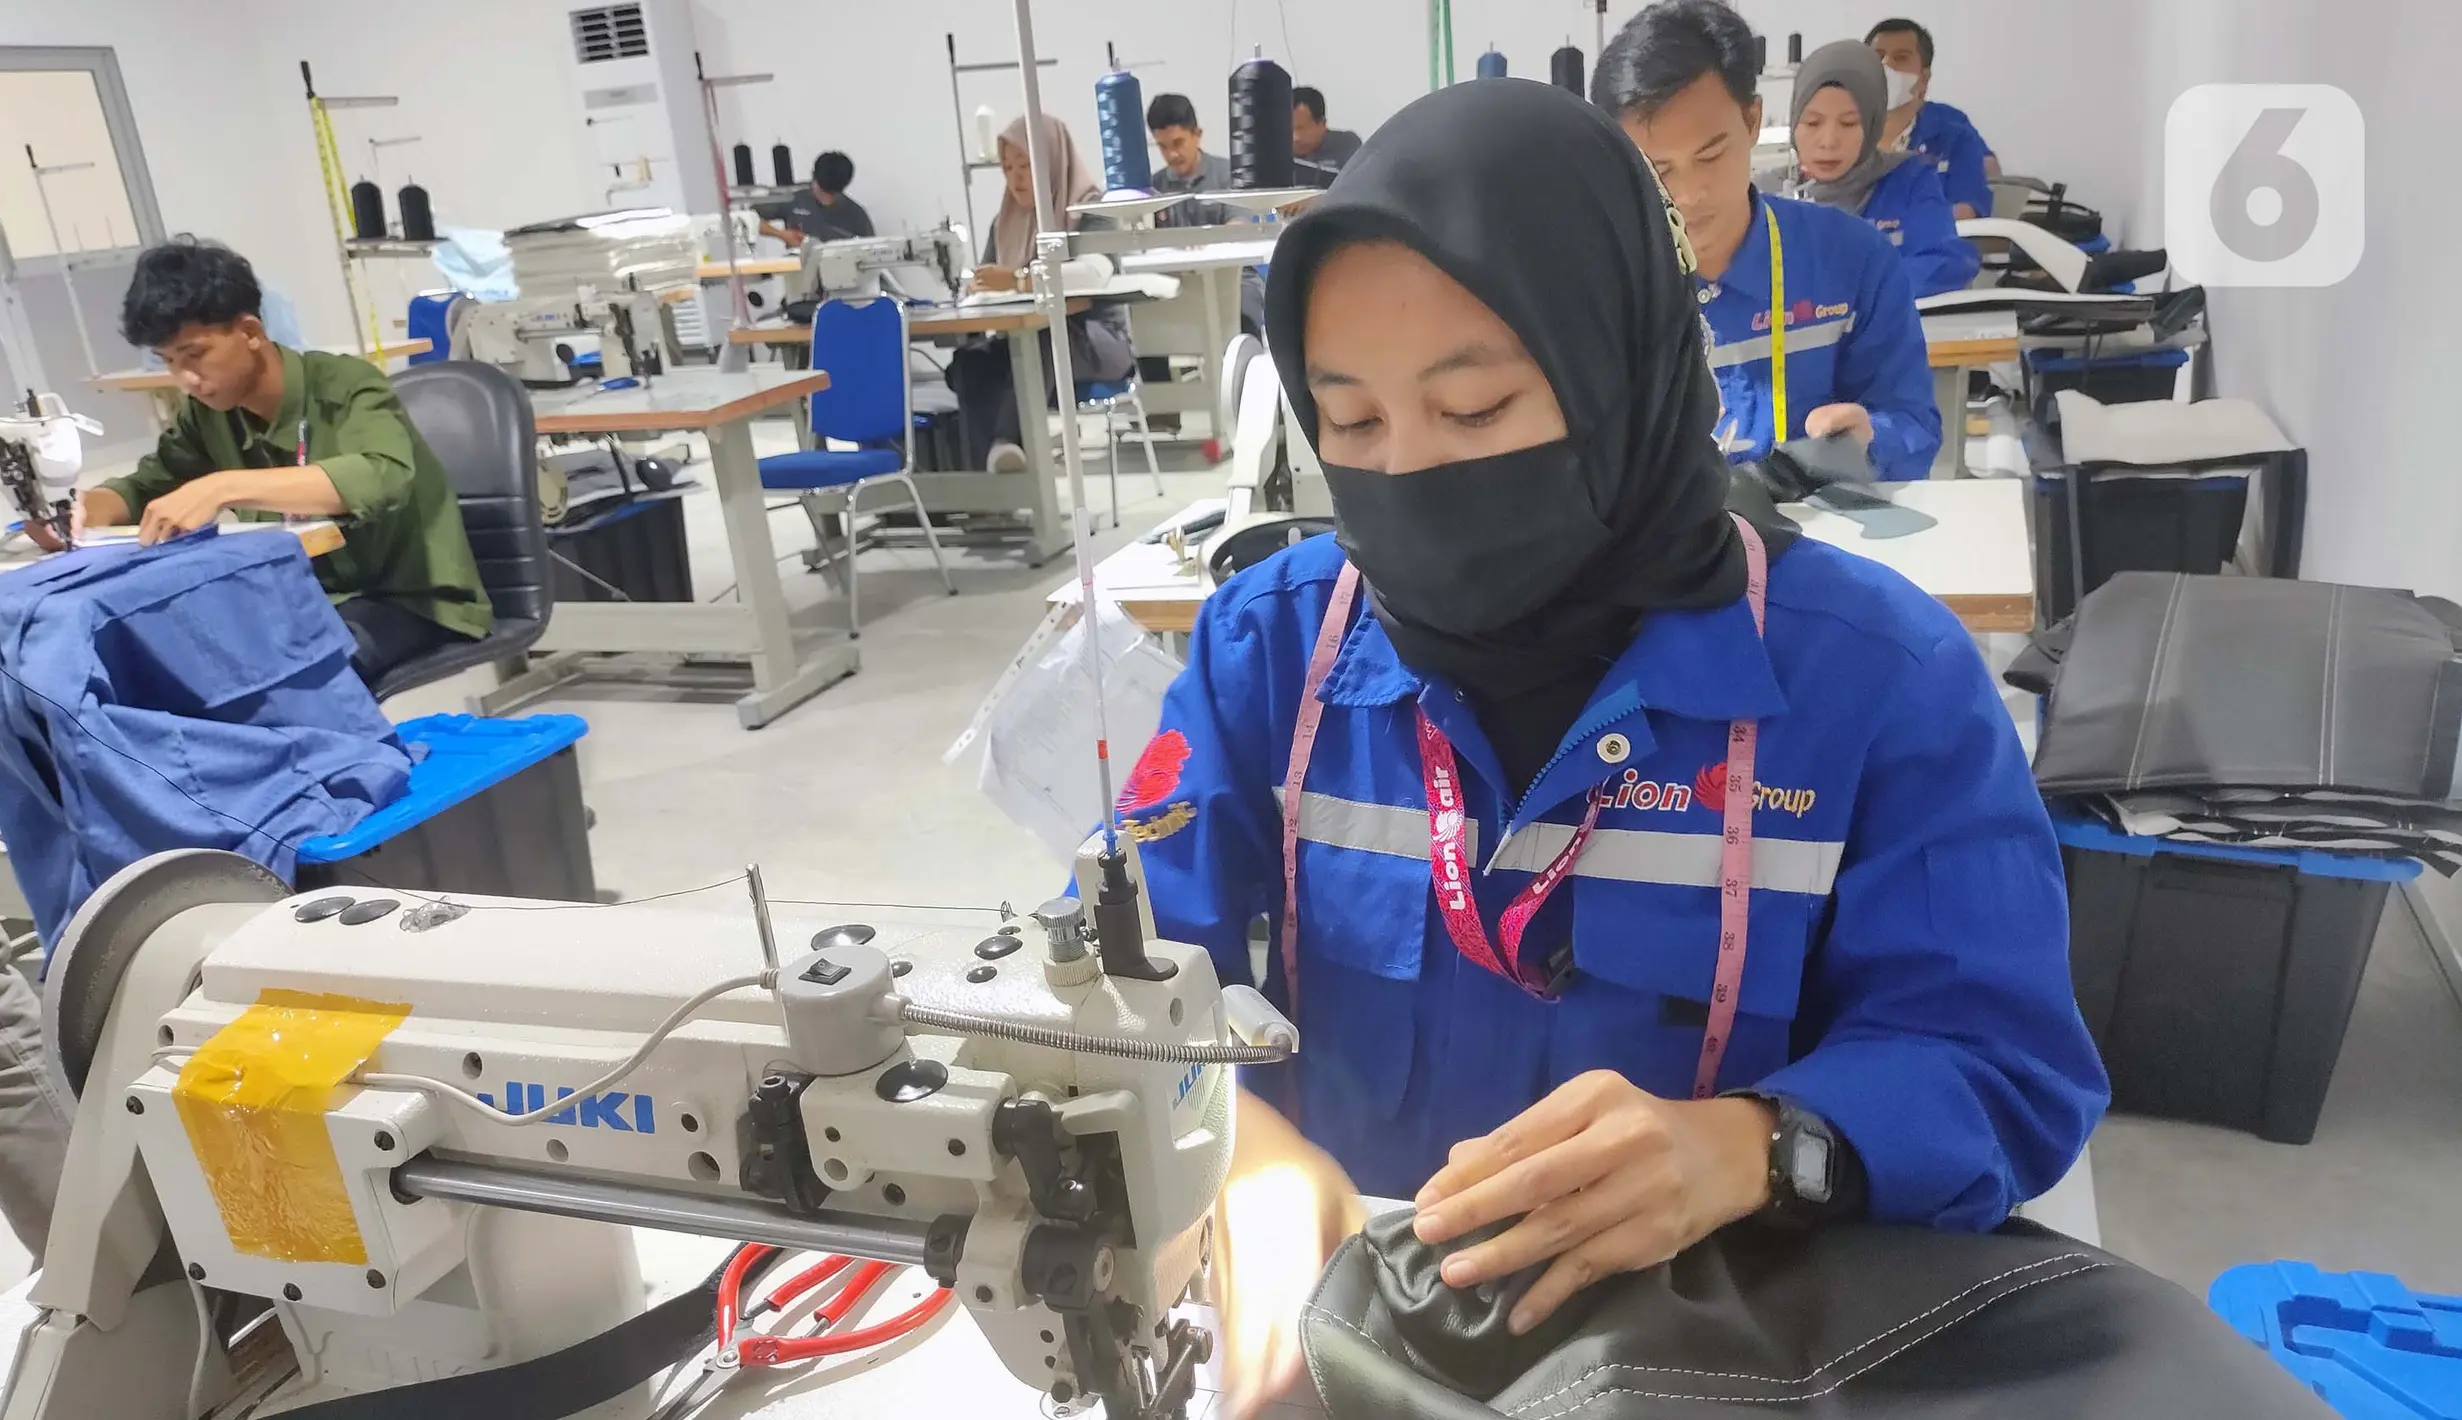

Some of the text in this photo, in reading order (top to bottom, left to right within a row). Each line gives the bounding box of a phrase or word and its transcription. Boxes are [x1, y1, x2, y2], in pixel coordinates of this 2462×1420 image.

[1815, 302, 1848, 319] Group
[1732, 725, 1747, 743] 34
[1729, 774, 1742, 793] 35
[1434, 766, 1466, 911] Lion air
[1726, 826, 1740, 845] 36
[1725, 877, 1738, 898] 37
[1724, 931, 1735, 951] 38
[477, 1081, 655, 1135] JUKI
